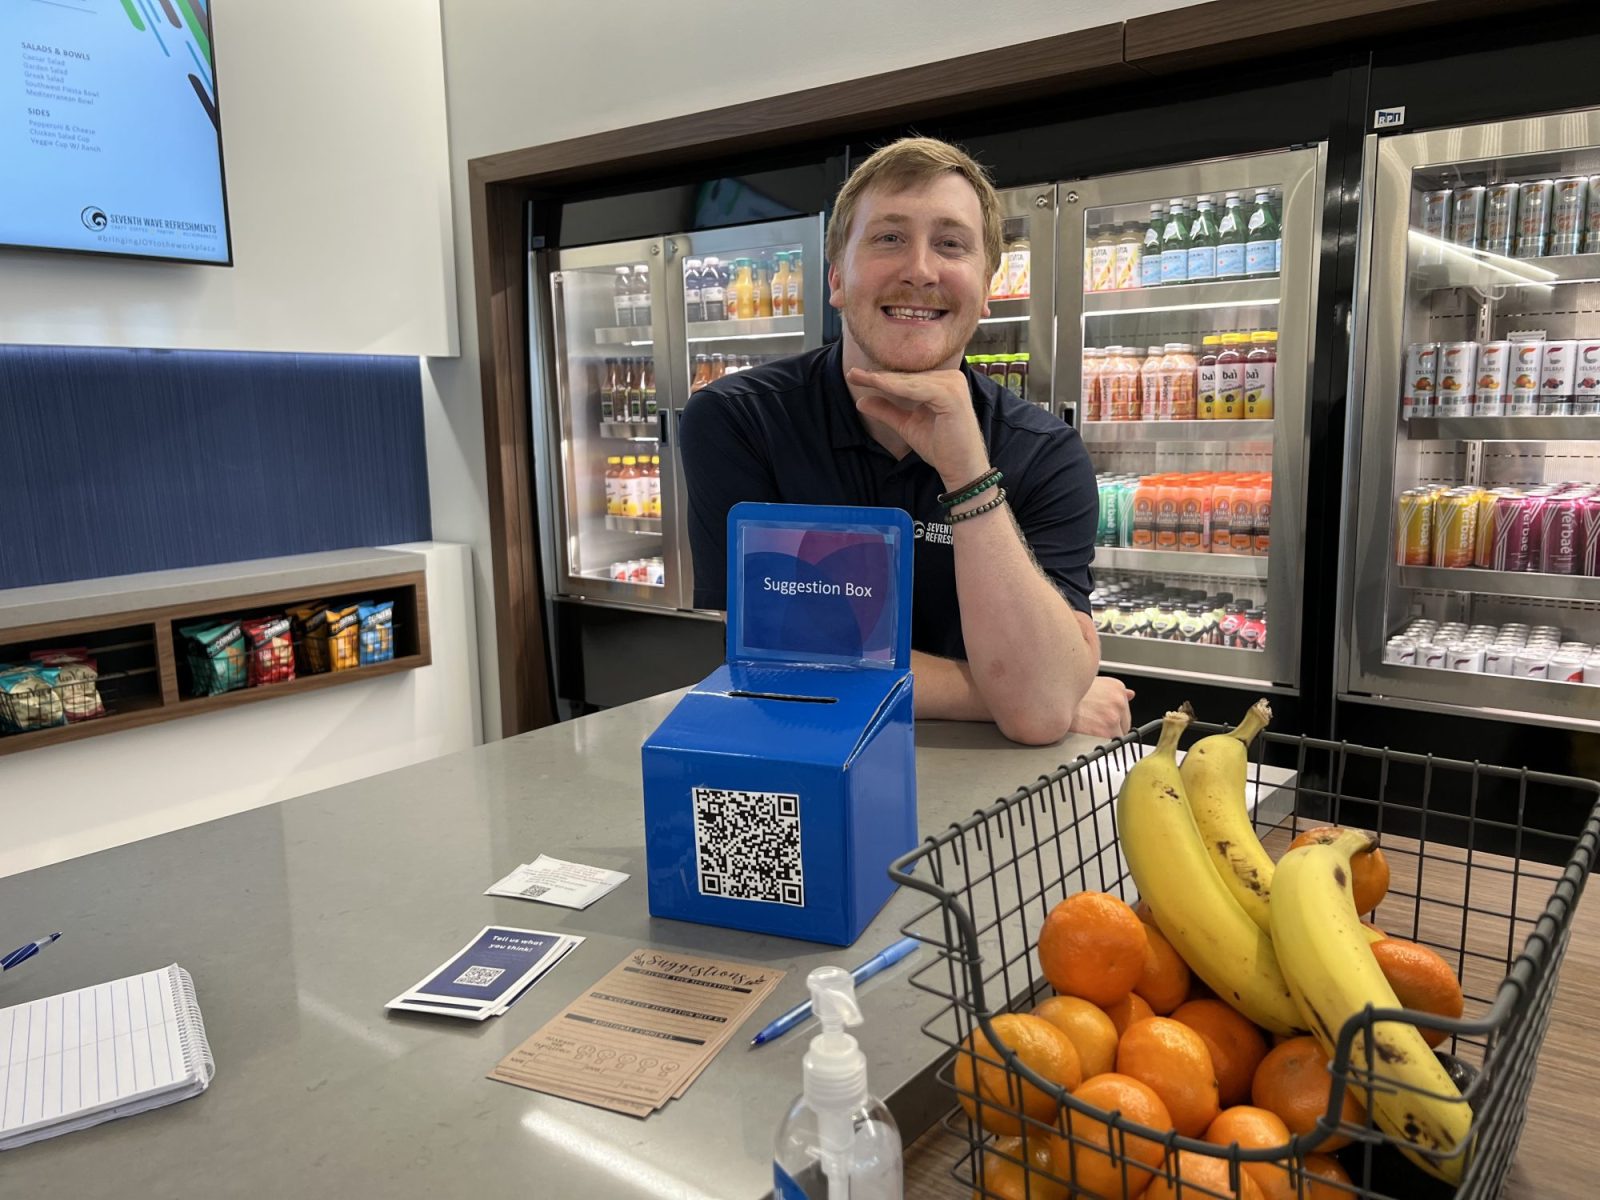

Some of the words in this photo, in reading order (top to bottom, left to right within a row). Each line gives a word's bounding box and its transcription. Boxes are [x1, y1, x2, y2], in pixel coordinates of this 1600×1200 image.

[21, 42, 52, 54] SALADS
[54, 48, 61, 56] &
[63, 50, 90, 61] BOWLS
[47, 57, 65, 66] Salad
[50, 66, 68, 76] Salad
[24, 71, 44, 80] Greek
[46, 74, 64, 84] Salad
[83, 89, 100, 98] Bowl
[78, 97, 94, 105] Bowl
[28, 107, 50, 118] SIDES
[58, 132, 76, 141] Salad
[77, 135, 91, 144] Cup
[55, 140, 68, 149] Cup
[110, 214, 142, 227] SEVENTH
[144, 217, 163, 229] WAVE
[165, 219, 217, 234] REFRESHMENTS
[763, 576, 841, 597] Suggestion
[845, 582, 873, 598] Box
[506, 945, 533, 953] think!
[647, 953, 746, 986] Suggestions
